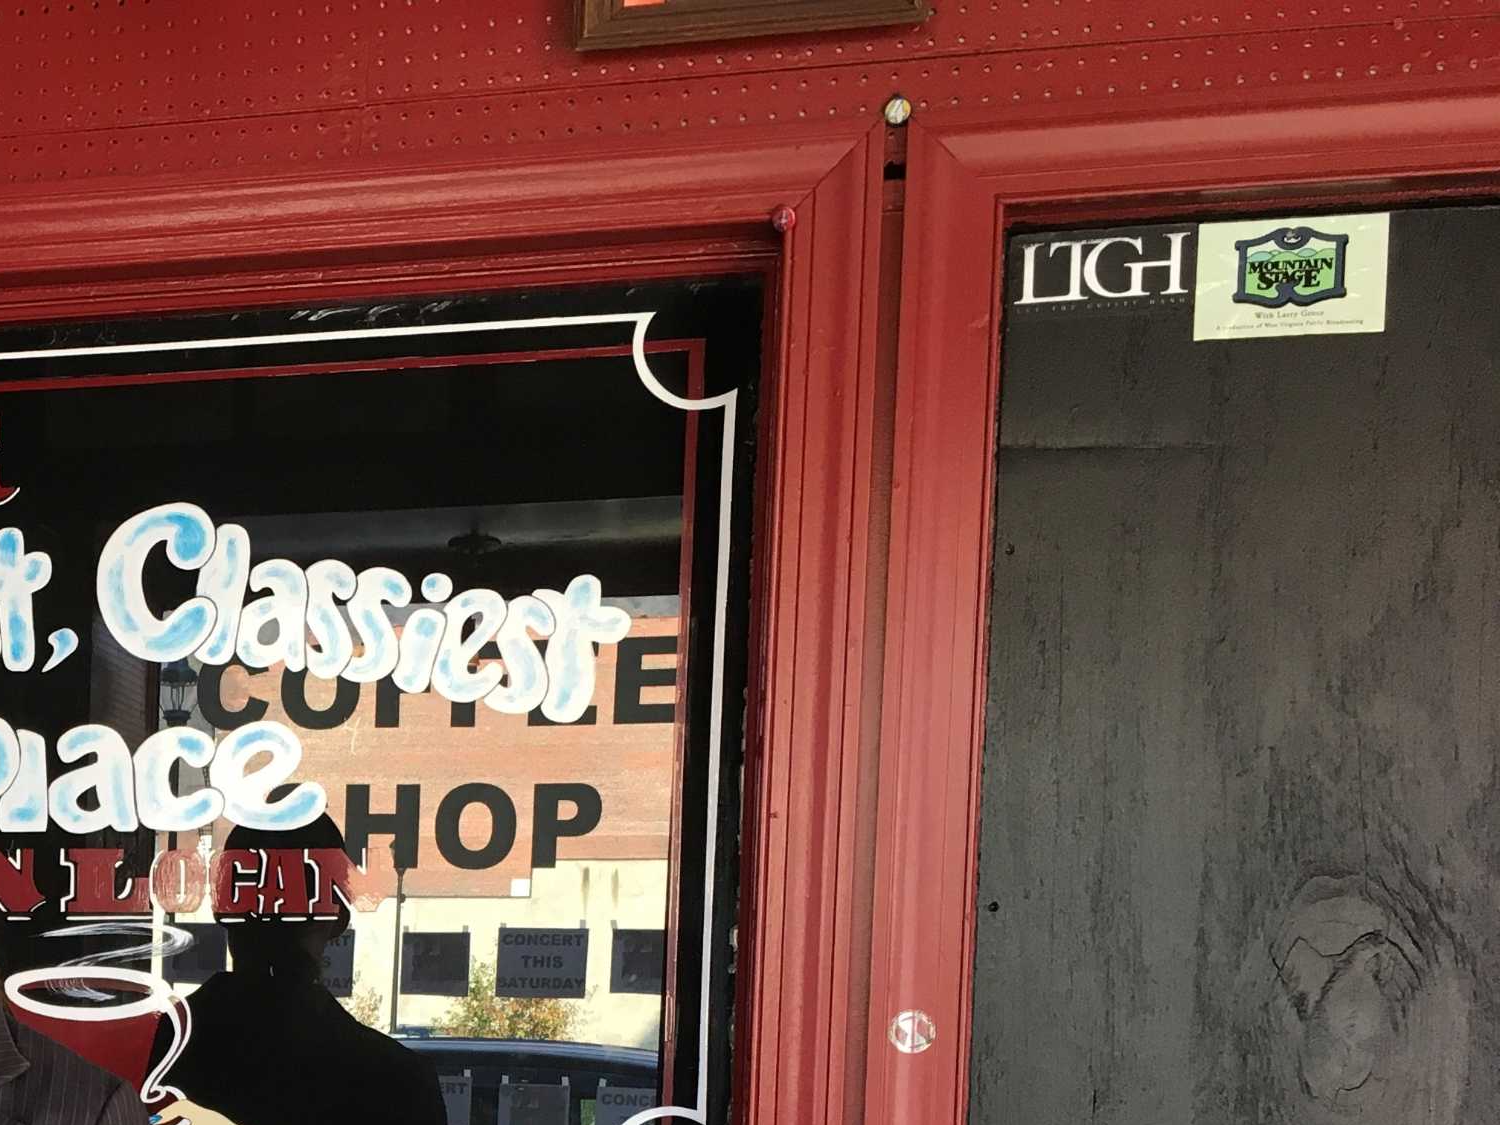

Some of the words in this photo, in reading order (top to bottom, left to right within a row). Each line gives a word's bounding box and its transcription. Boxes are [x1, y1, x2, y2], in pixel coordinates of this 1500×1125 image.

[1248, 257, 1334, 275] MOUNTAIN
[1257, 268, 1321, 290] STAGE
[97, 502, 633, 723] Classiest
[198, 634, 678, 731] COE
[267, 782, 603, 870] HOP
[60, 848, 398, 923] LOGAN
[501, 933, 585, 947] CONCERT
[521, 954, 564, 969] THIS
[499, 977, 584, 990] SATURDAY
